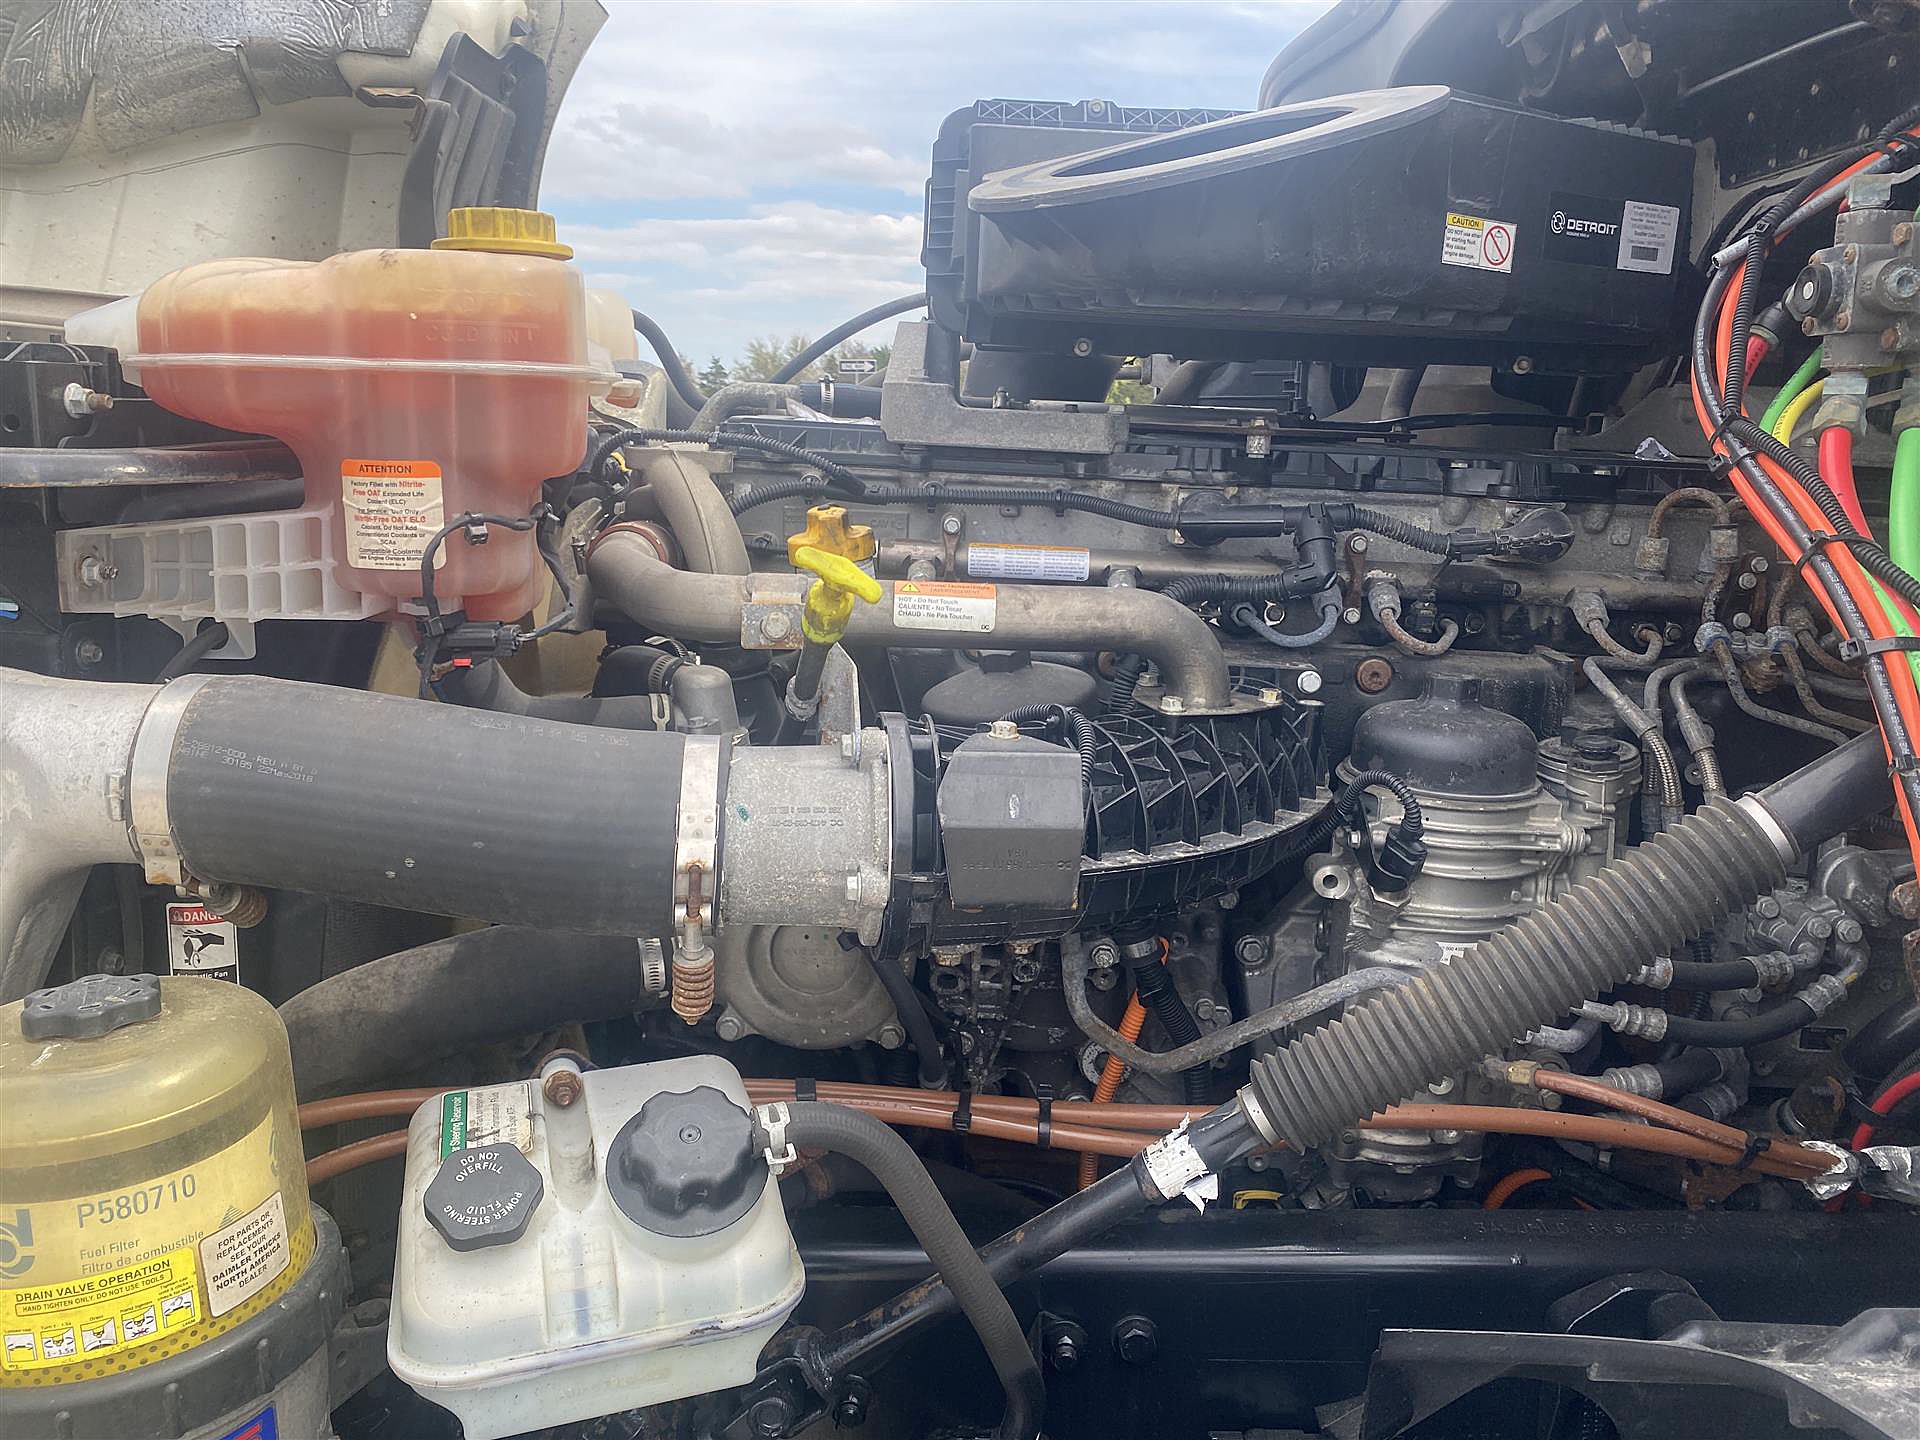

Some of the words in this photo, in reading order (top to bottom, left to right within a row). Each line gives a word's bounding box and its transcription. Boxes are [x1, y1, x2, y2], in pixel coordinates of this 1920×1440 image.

[1452, 216, 1480, 227] CAUTION
[1566, 218, 1618, 236] DETROIT
[359, 464, 412, 473] ATTENTION
[350, 480, 368, 488] Factory
[389, 498, 406, 506] (ELC)
[391, 515, 407, 523] OAT
[409, 515, 426, 523] ELC
[359, 547, 391, 555] Compatible
[183, 911, 223, 921] DANG
[450, 1096, 463, 1122] Reservoir
[449, 1122, 463, 1146] Steering
[460, 1155, 475, 1167] DO
[479, 1151, 500, 1161] NOT
[455, 1161, 504, 1183] OVERFILL
[76, 1174, 196, 1228] P580710
[466, 1200, 502, 1215] FLUID
[494, 1191, 523, 1220] POWER
[443, 1204, 491, 1226] STEERING
[216, 1218, 274, 1261] REPLACEMENTS
[217, 1235, 235, 1250] FOR
[236, 1218, 260, 1238] PARTS
[260, 1211, 271, 1222] OR
[80, 1244, 106, 1260] Fuel
[109, 1238, 140, 1253] Filter
[81, 1261, 113, 1275] Filtro
[117, 1255, 132, 1267] de
[135, 1231, 204, 1261] combustible
[212, 1255, 252, 1283] DAIMLER
[253, 1232, 281, 1258] TRUCKS
[230, 1249, 246, 1263] SEE
[246, 1234, 267, 1252] YOUR
[216, 1268, 248, 1291] NORTH
[249, 1242, 281, 1272] AMERICA
[238, 1264, 268, 1288] DEALER
[15, 1289, 53, 1302] DRAIN
[56, 1281, 95, 1296] VALVE
[98, 1259, 171, 1288] OPERATION
[22, 1303, 42, 1313] HAND
[43, 1299, 74, 1311] TIGHTEN
[96, 1291, 107, 1300] DO
[109, 1287, 124, 1297] NOT
[125, 1283, 140, 1292] USE
[141, 1274, 165, 1289] TOOLS
